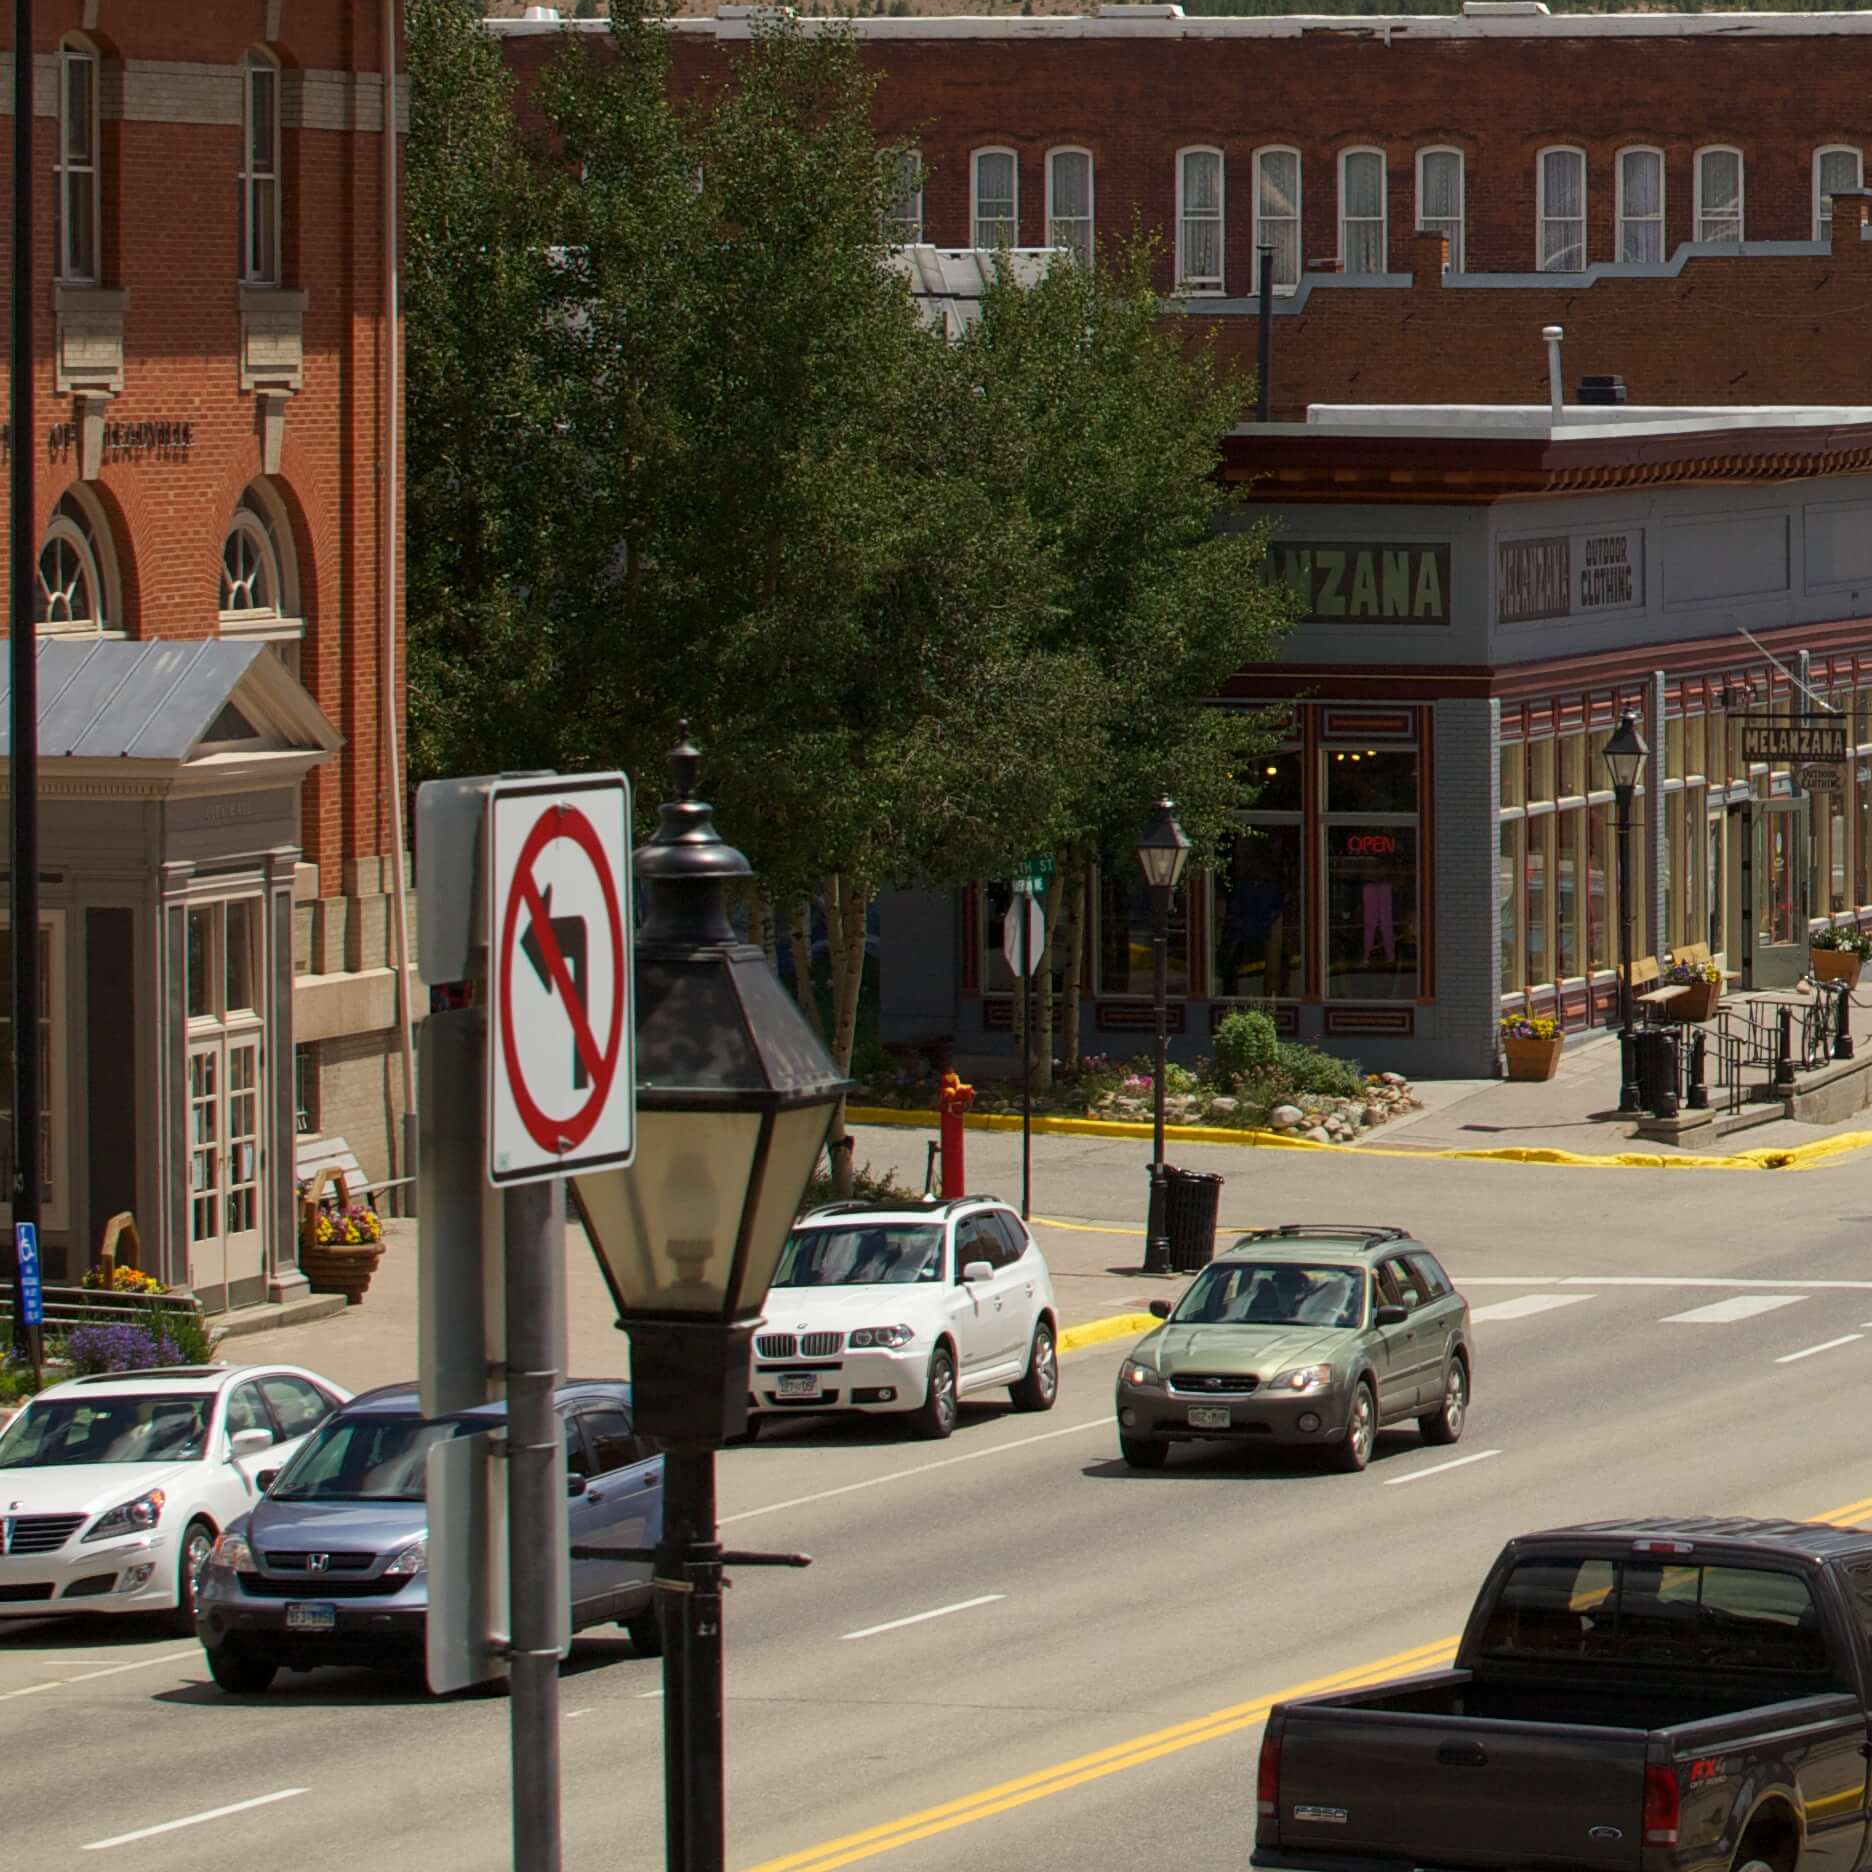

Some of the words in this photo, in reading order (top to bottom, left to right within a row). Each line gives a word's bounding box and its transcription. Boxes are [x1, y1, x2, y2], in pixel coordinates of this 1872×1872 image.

[1585, 535, 1628, 567] OUTDOOR
[1265, 549, 1443, 617] NZANA
[1580, 565, 1632, 607] CLOTHING
[1745, 730, 1843, 754] MELANZANA
[1346, 835, 1395, 854] OPEN
[1039, 859, 1054, 873] ST
[1691, 1756, 1726, 1783] FX4
